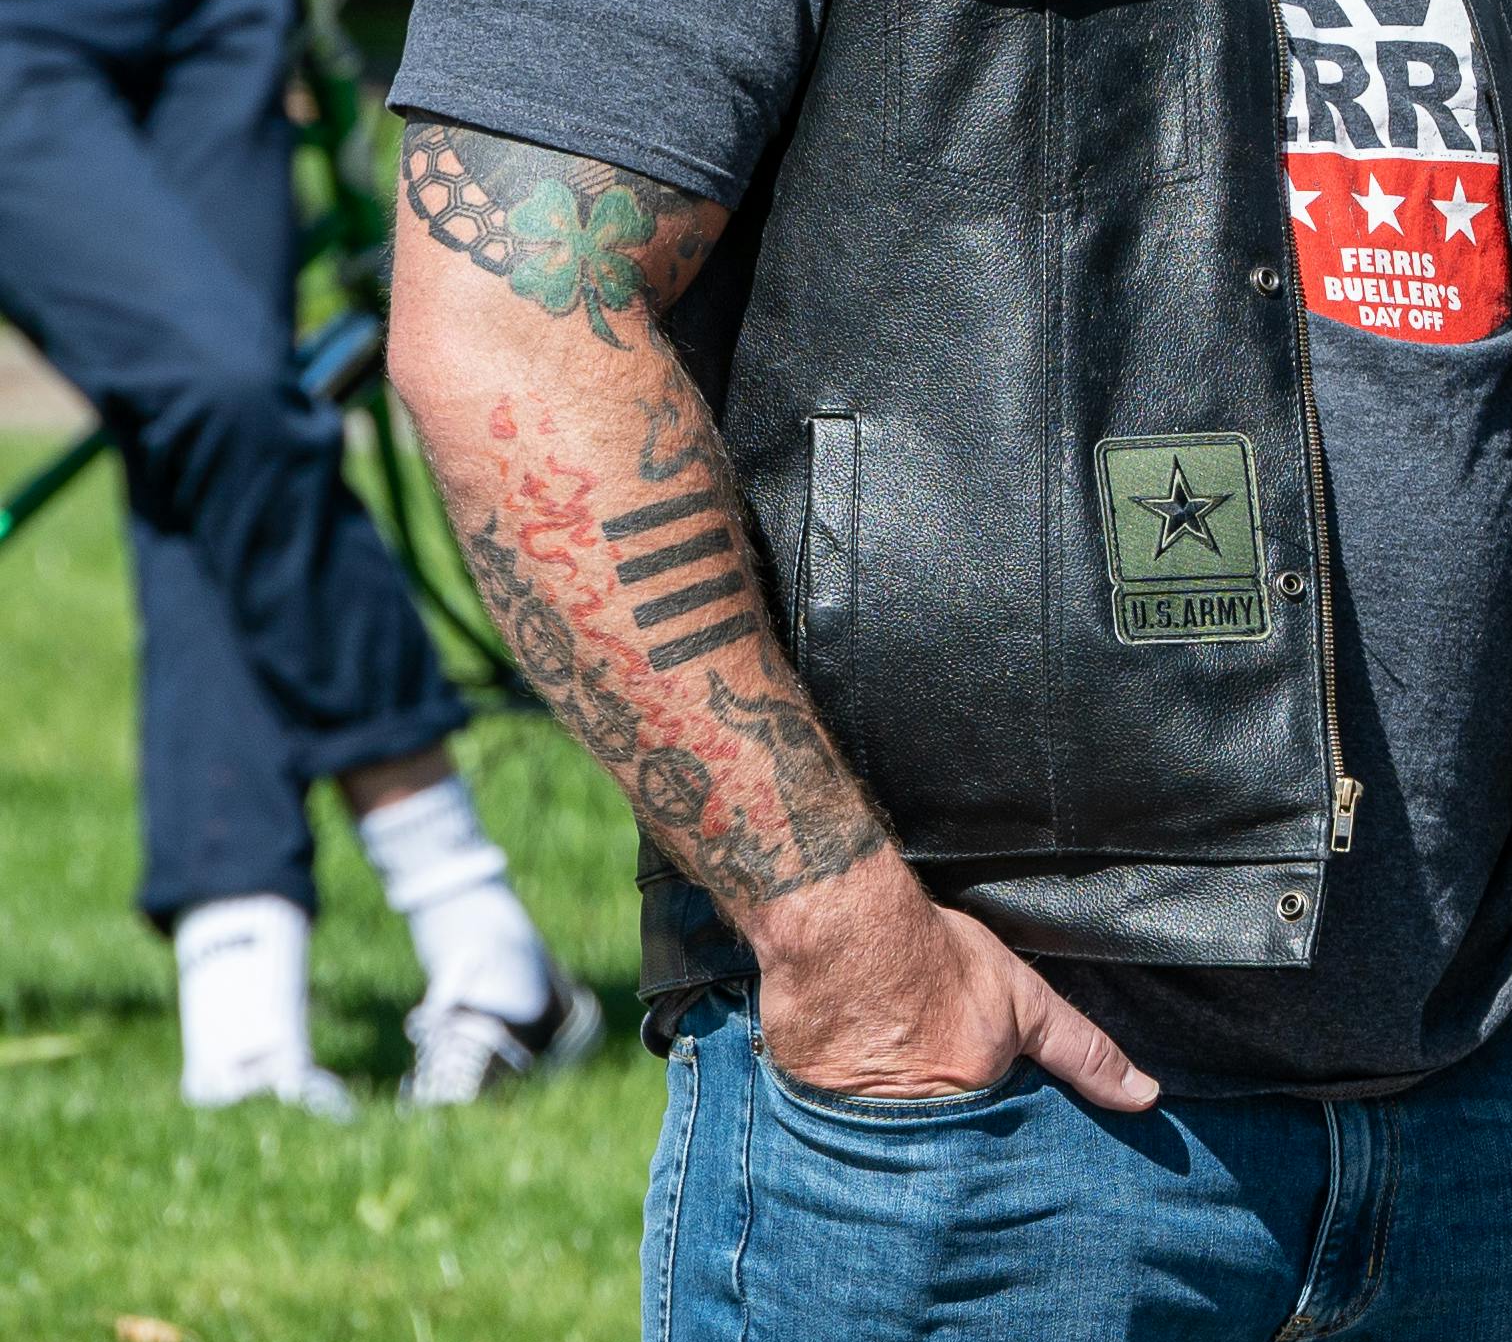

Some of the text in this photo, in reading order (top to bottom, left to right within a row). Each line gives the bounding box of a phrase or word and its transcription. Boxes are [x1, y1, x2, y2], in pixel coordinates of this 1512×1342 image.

[1339, 245, 1437, 279] FERRIS
[1322, 274, 1463, 312] BUELLER'S
[1357, 304, 1445, 332] DAY OFF
